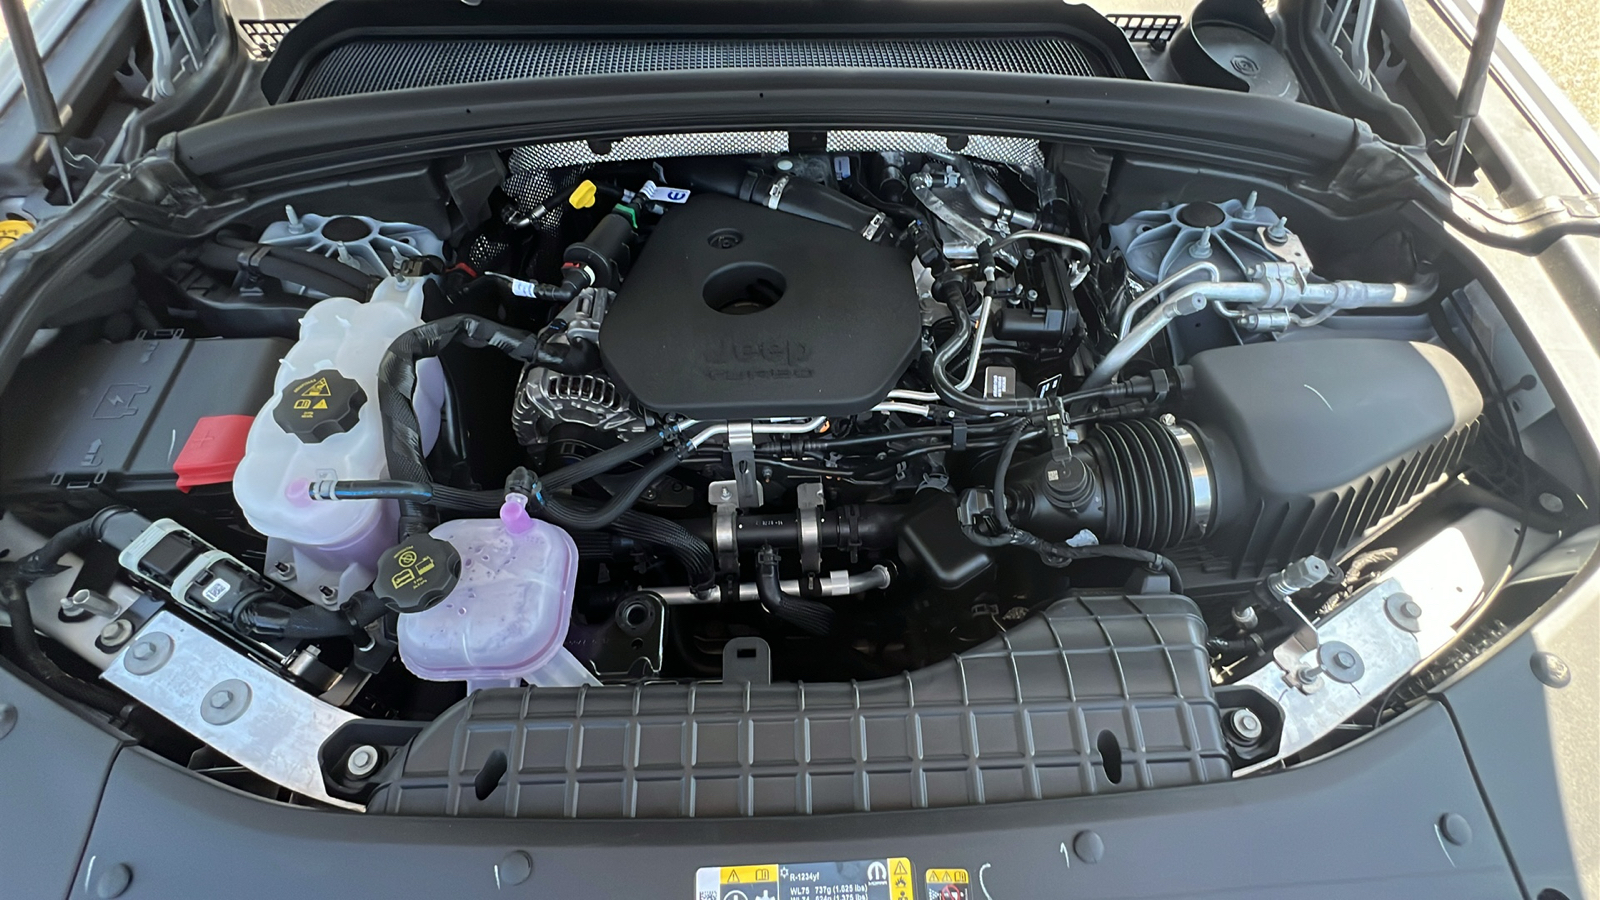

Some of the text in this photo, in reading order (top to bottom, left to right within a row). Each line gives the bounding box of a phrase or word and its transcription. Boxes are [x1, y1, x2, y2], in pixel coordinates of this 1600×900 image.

[703, 339, 812, 366] Jeep
[790, 871, 820, 882] R-1234yf
[789, 883, 868, 895] WL75 737g (1.625 lbs)
